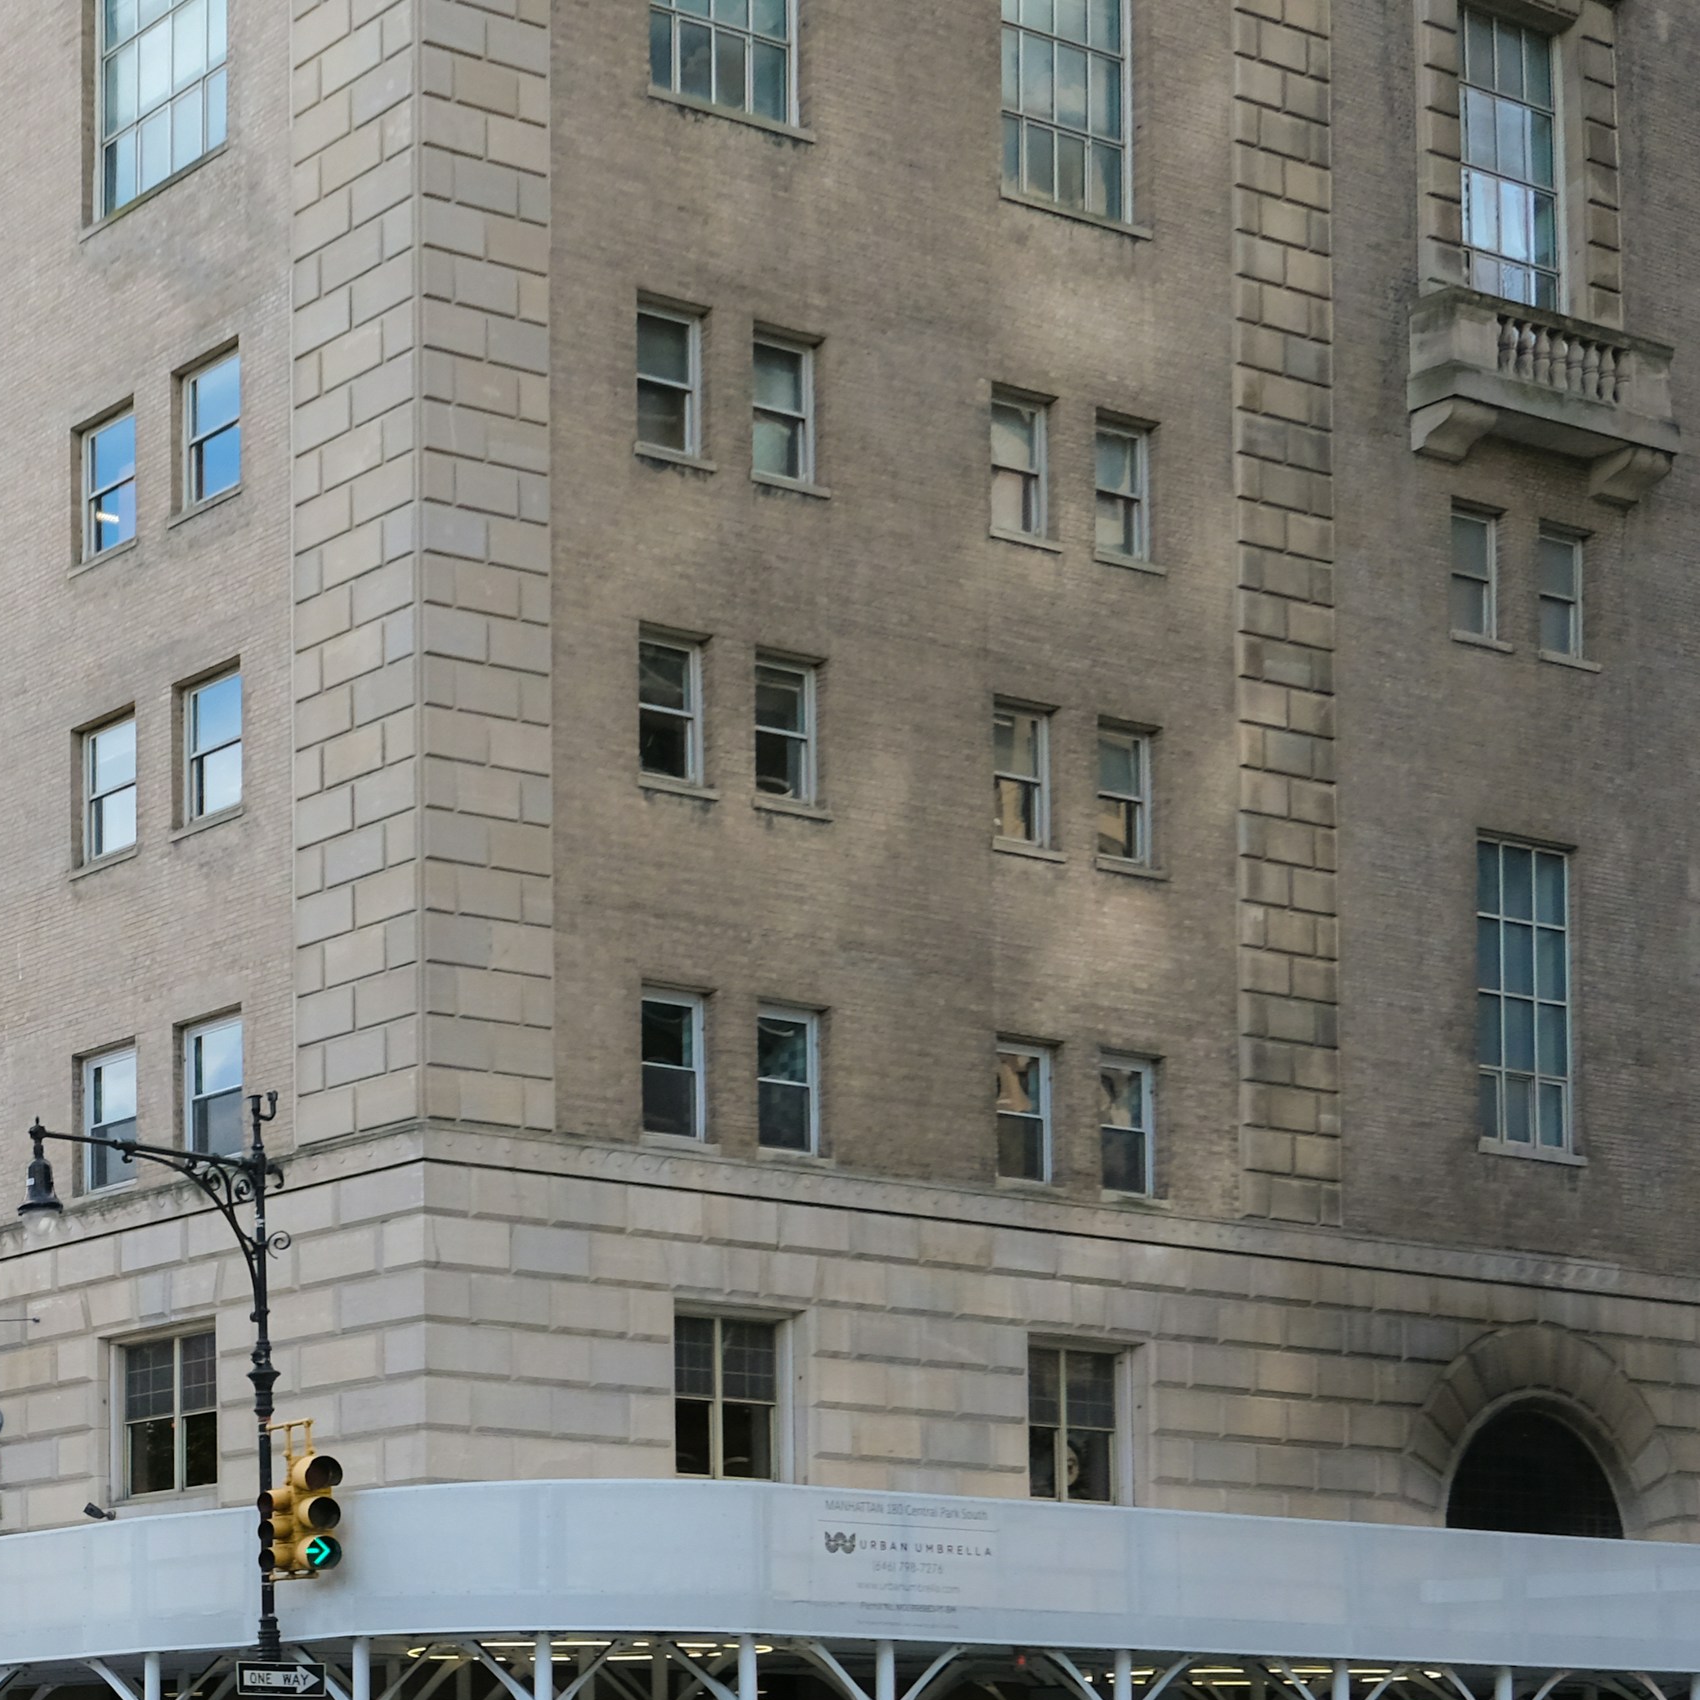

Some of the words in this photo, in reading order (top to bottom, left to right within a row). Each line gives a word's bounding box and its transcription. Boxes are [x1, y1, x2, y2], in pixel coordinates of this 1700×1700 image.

[825, 1500, 884, 1514] MANHATTAN
[887, 1504, 903, 1515] 180
[905, 1504, 938, 1517] Central
[940, 1506, 959, 1519] Park
[962, 1508, 989, 1520] South
[859, 1539, 908, 1551] URBAN
[915, 1543, 992, 1556] UMBRELLA
[249, 1672, 273, 1685] ONE
[282, 1673, 309, 1686] WAY
